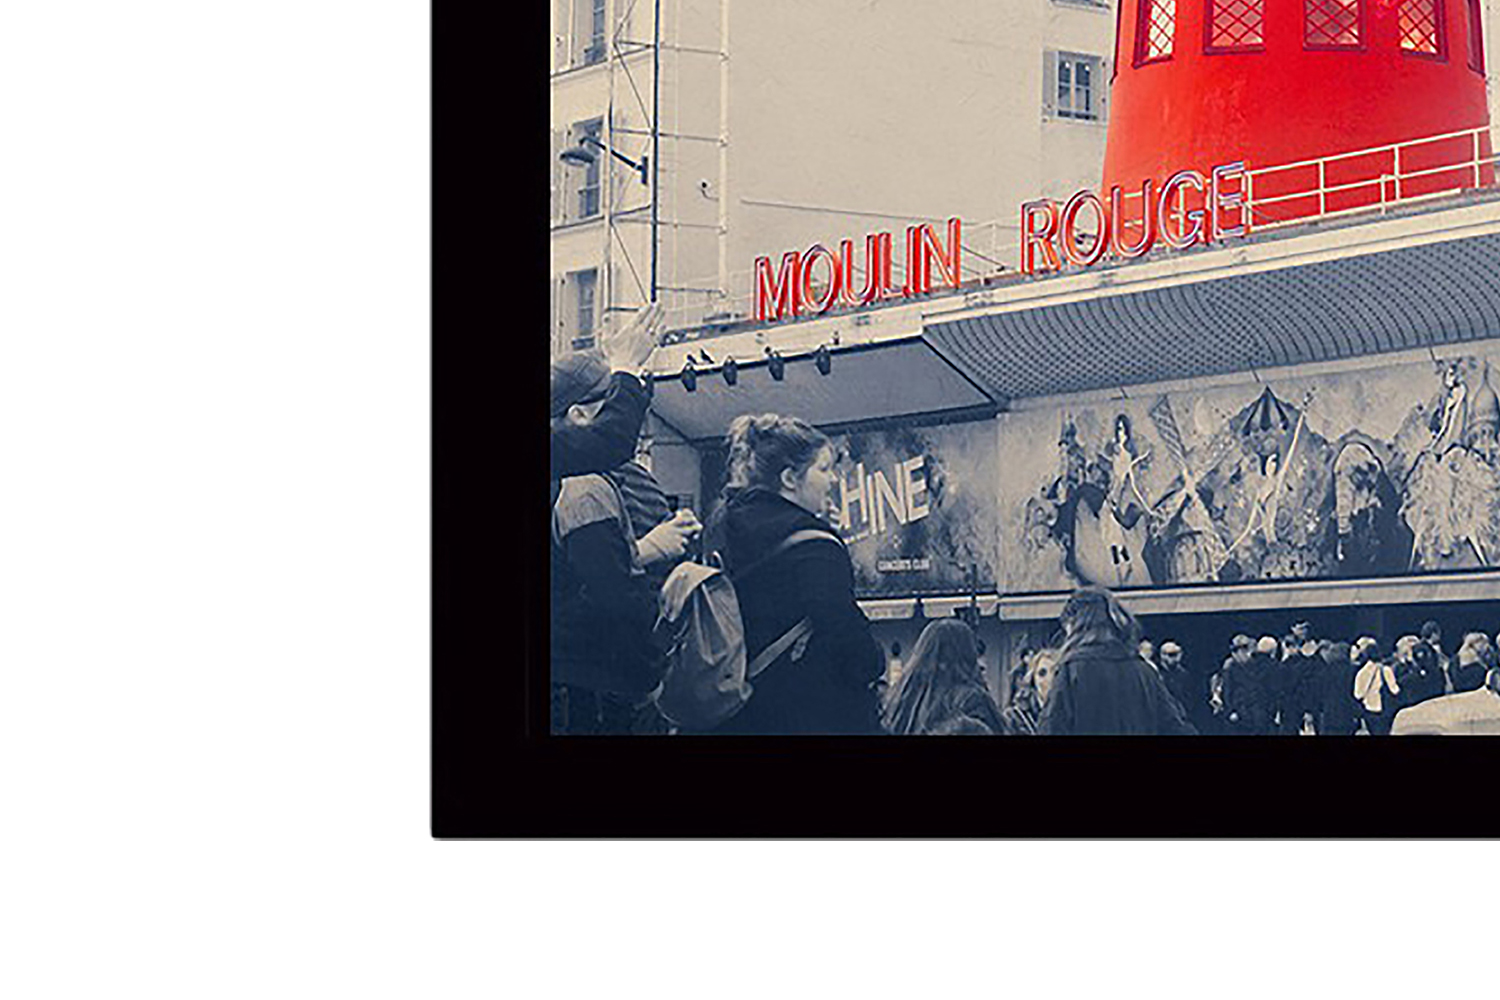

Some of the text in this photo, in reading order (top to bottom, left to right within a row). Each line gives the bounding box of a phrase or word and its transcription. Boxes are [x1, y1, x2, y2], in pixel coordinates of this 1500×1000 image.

[754, 160, 1254, 322] MOULIN ROUGE
[830, 455, 930, 536] HINE
